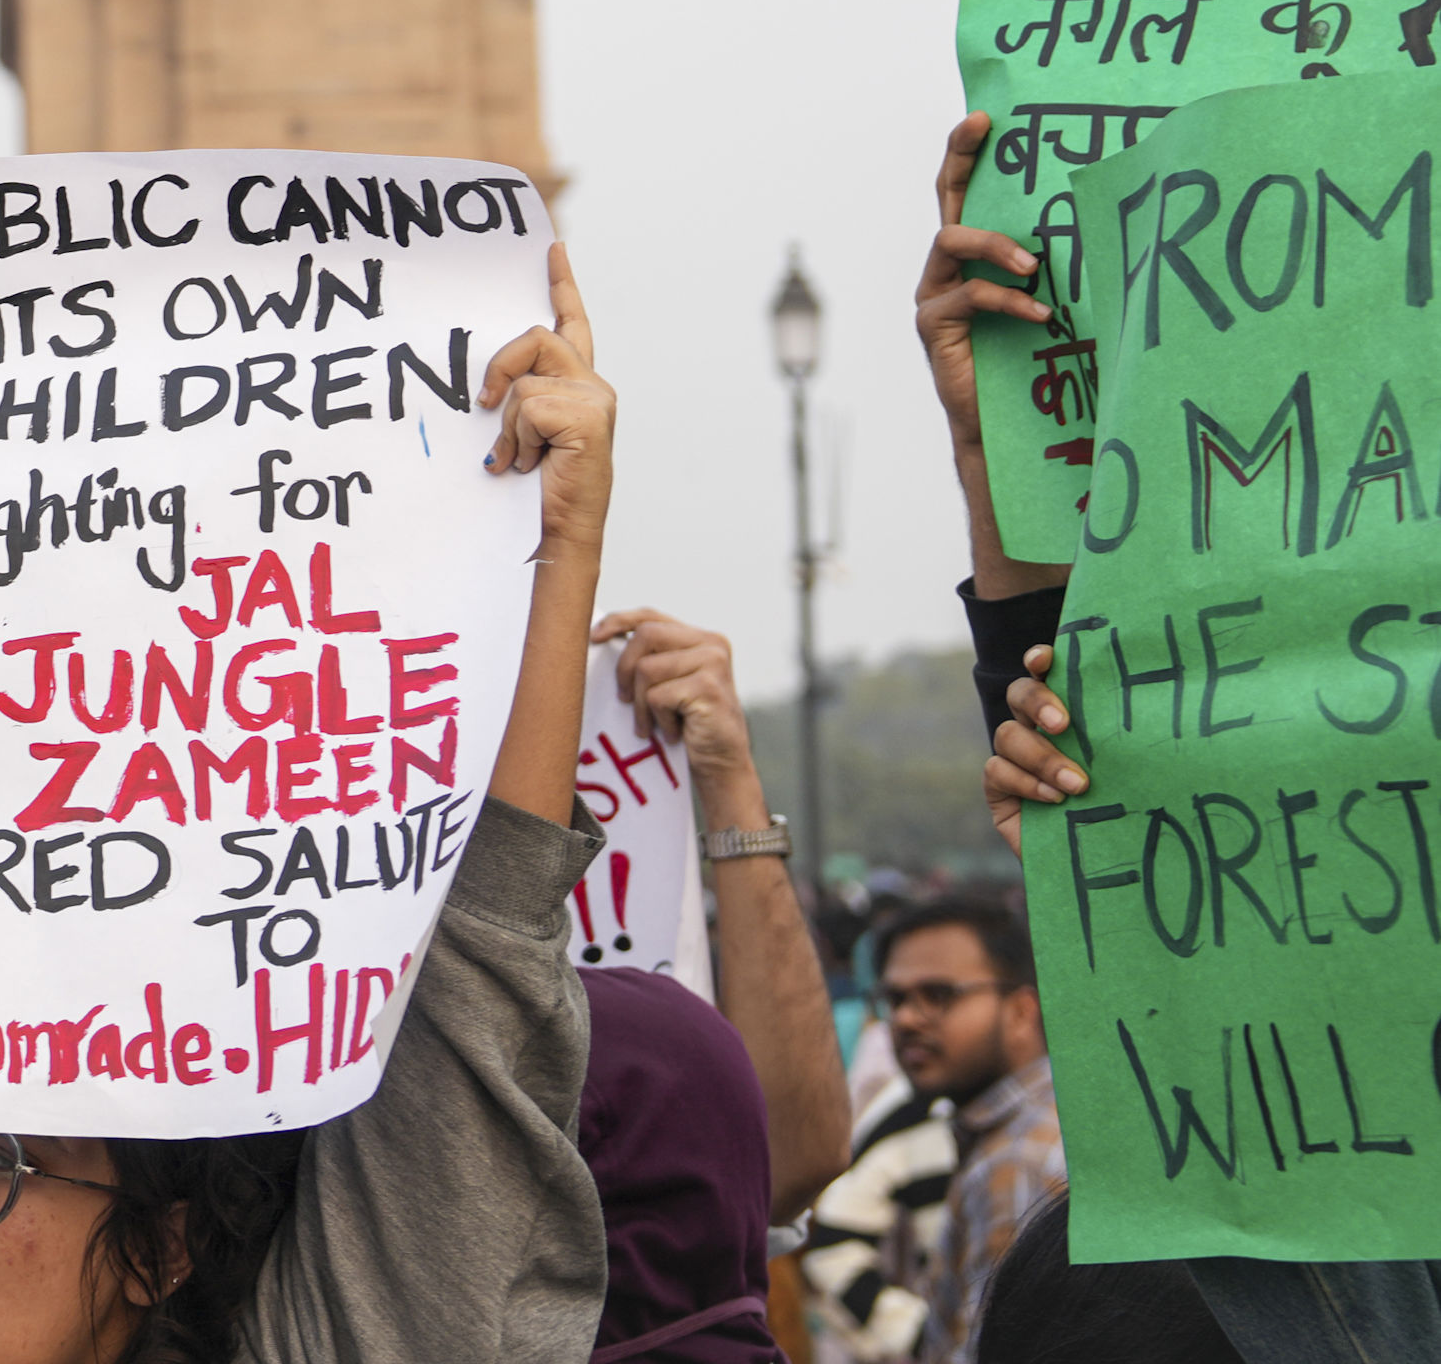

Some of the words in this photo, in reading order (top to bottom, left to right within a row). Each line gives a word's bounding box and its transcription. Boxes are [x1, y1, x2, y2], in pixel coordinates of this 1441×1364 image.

[228, 175, 530, 248] CANNOT
[1118, 150, 1433, 352] FROM
[163, 253, 384, 342] OWN
[231, 449, 373, 534] for
[1181, 371, 1441, 557] MA
[178, 542, 381, 639] JAL
[1056, 595, 1265, 770] THE
[14, 717, 459, 833] ZAMEEN
[220, 789, 476, 901] SALUTE
[193, 905, 321, 988] TO
[1117, 1017, 1415, 1185] WILL
